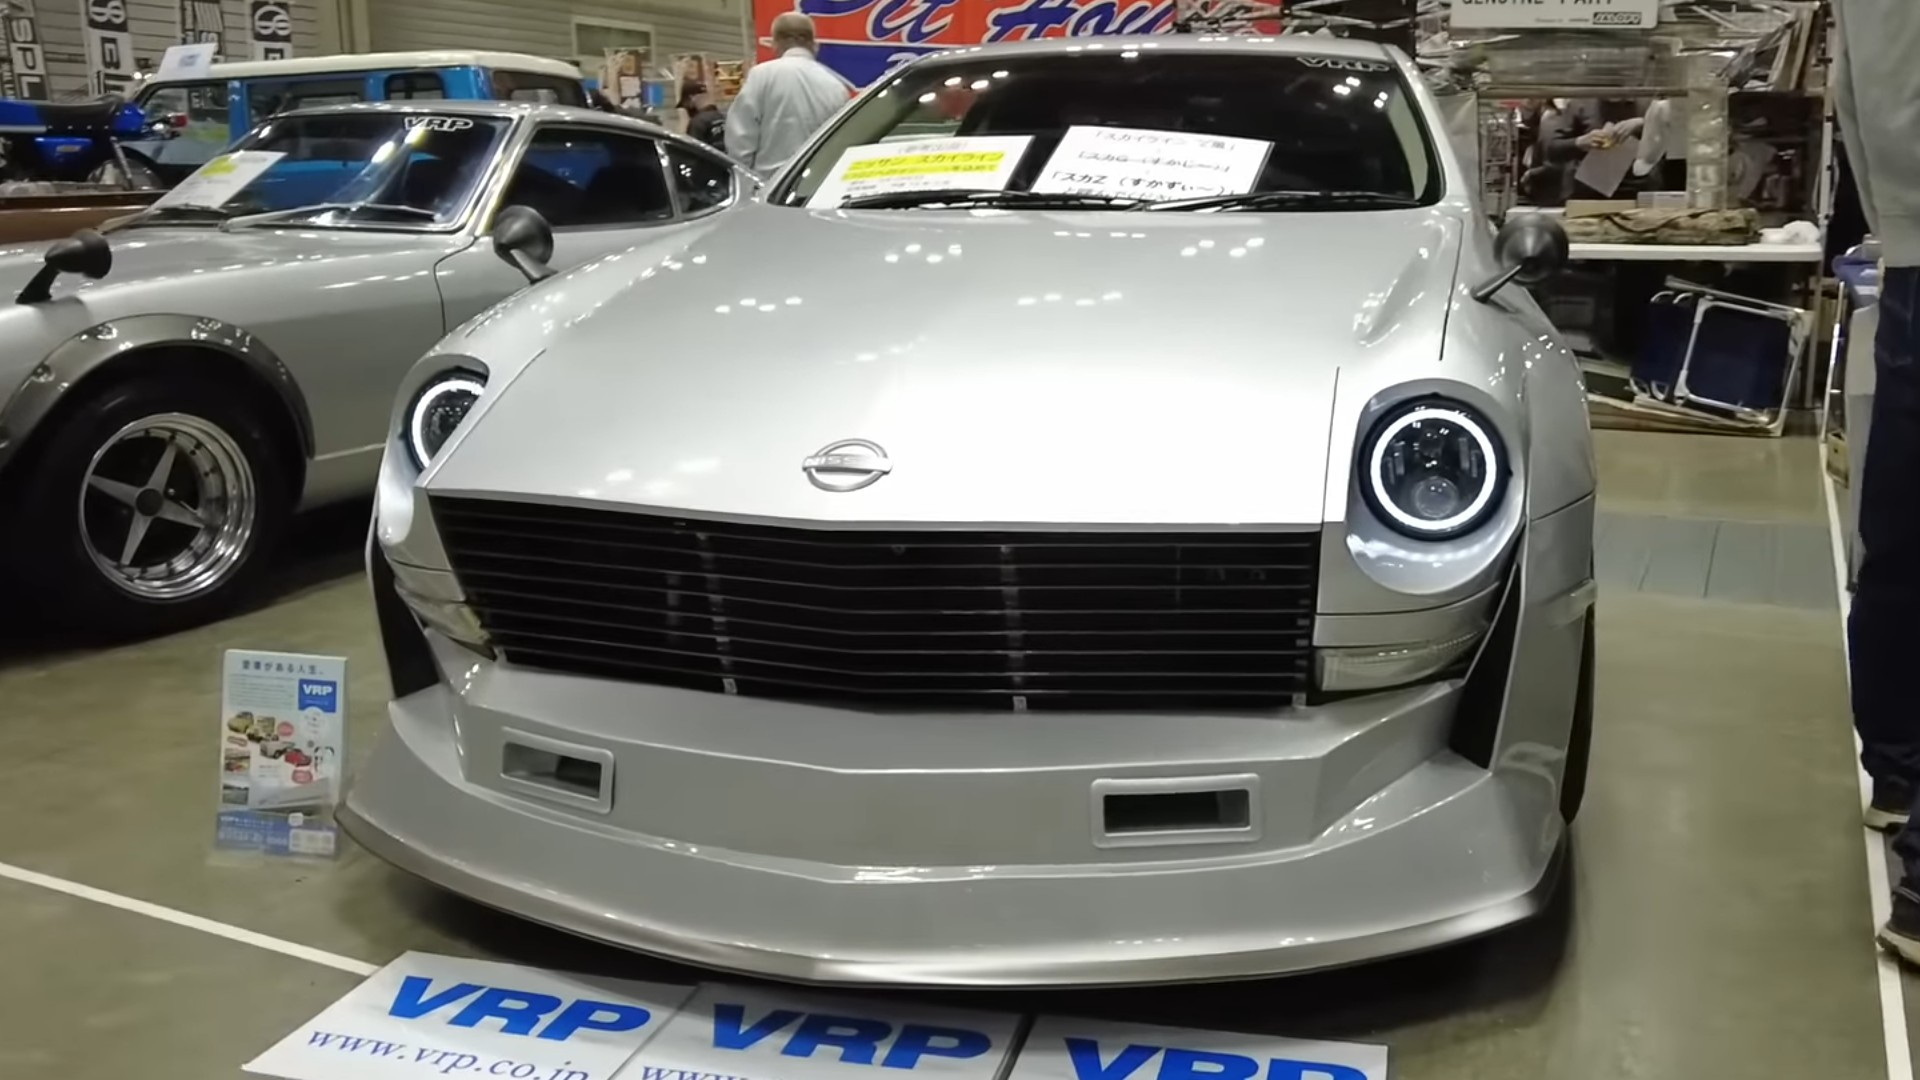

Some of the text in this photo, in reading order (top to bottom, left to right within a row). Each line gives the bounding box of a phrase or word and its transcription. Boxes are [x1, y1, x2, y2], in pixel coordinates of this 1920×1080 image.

[404, 116, 474, 131] VRP
[302, 683, 334, 697] VRP
[388, 975, 651, 1042] VRP
[712, 1003, 992, 1069] VRP
